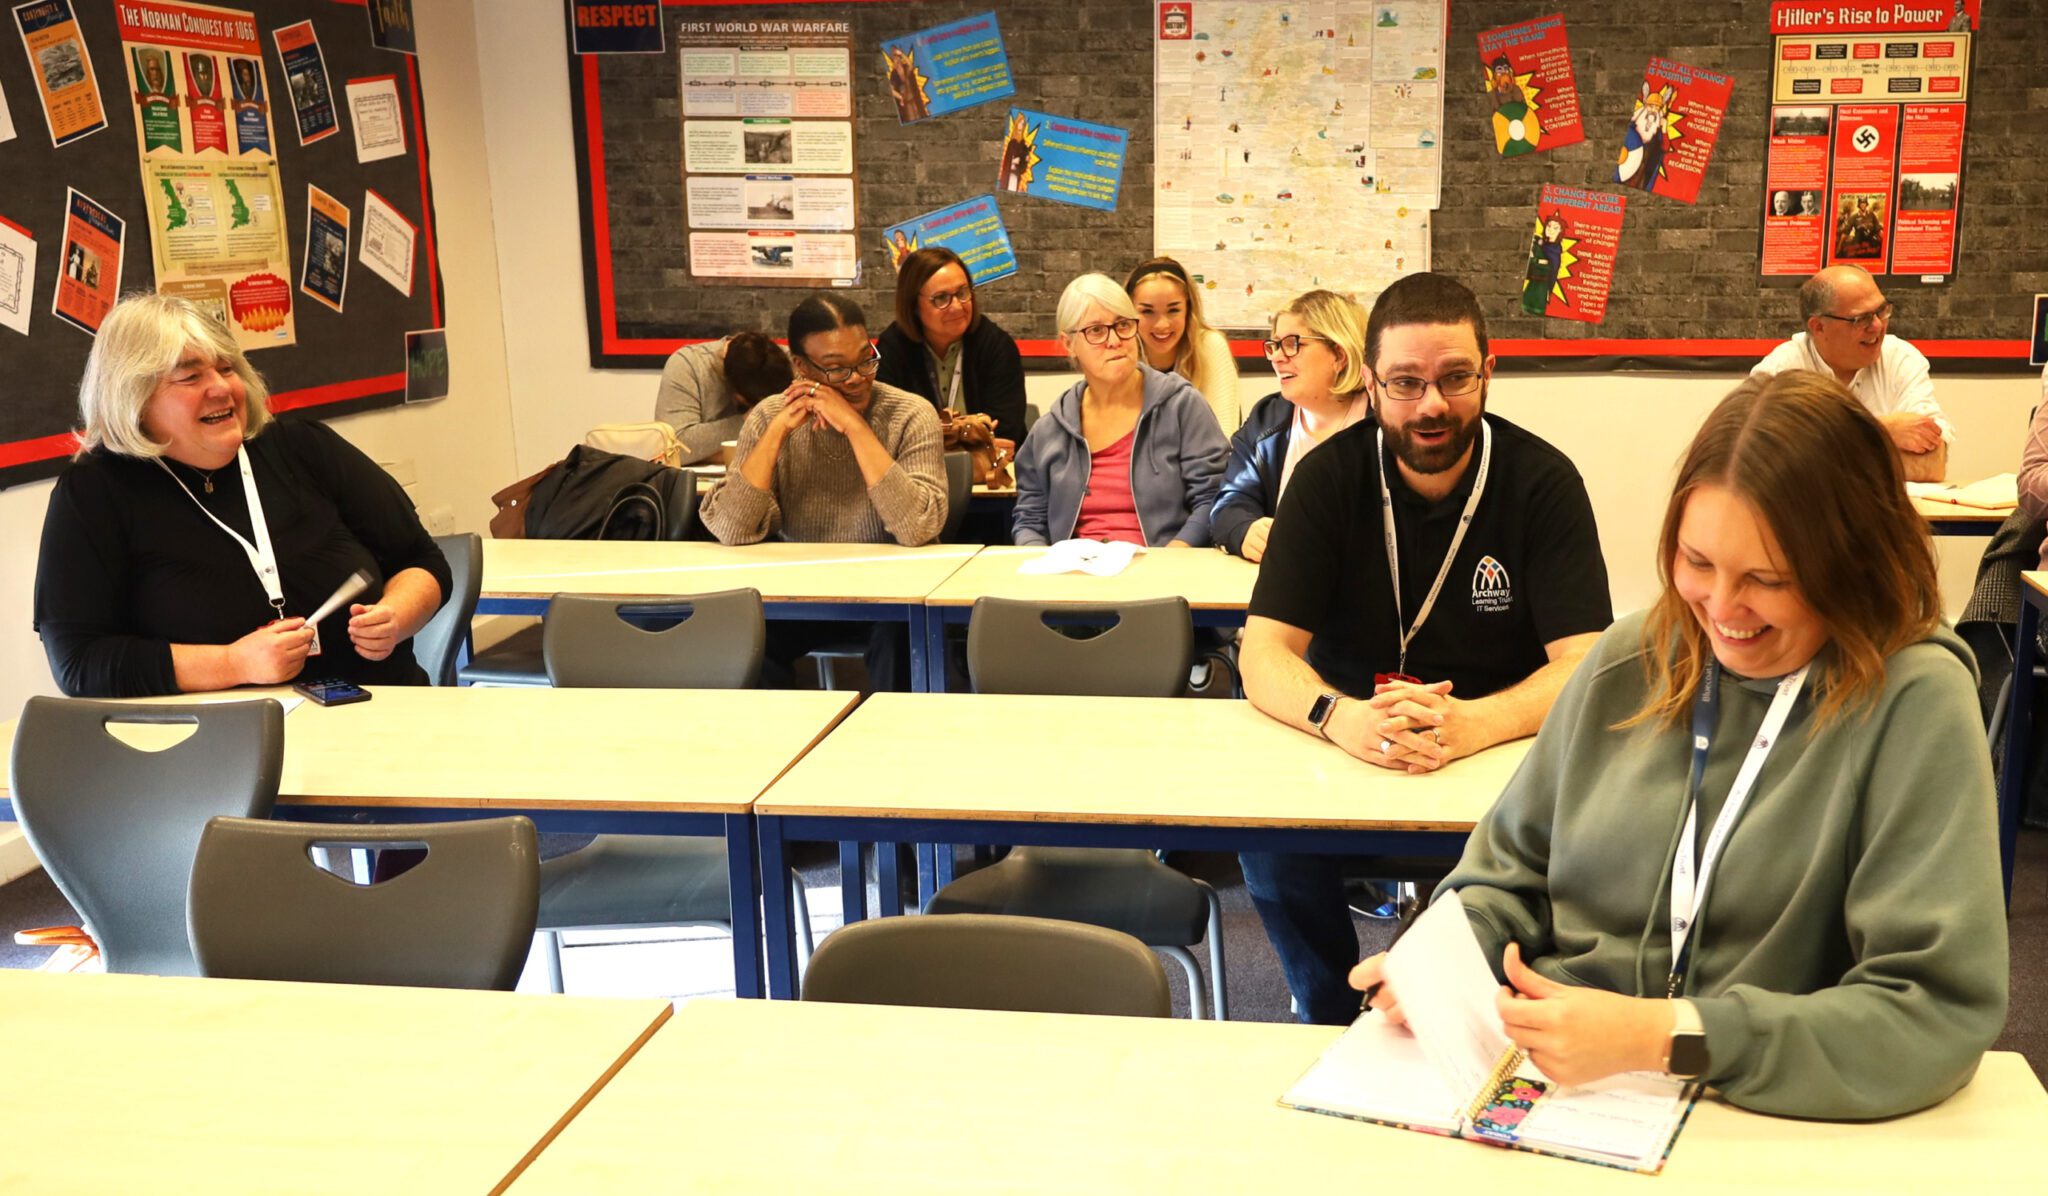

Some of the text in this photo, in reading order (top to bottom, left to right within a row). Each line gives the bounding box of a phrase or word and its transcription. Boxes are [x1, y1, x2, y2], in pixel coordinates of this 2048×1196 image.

[120, 4, 140, 26] THE
[140, 8, 182, 32] NORMAN
[182, 12, 223, 36] CONQUEST
[235, 20, 256, 41] 1066
[577, 4, 656, 28] RESPECT
[1777, 4, 1943, 28] Hitler's Rise to Power
[681, 22, 849, 32] FIRST WORLD WAR WARFARE
[1487, 24, 1532, 43] SOMETIMES
[1533, 17, 1560, 31] THINGS
[1483, 40, 1504, 53] STAY
[1504, 37, 1518, 48] THE
[1518, 44, 1567, 62] When something
[1539, 51, 1568, 63] becomes
[1545, 67, 1556, 76] call
[1557, 64, 1570, 73] that
[1658, 60, 1677, 71] NOT
[1678, 64, 1691, 75] ALL
[1691, 69, 1726, 85] CHANGE
[1556, 84, 1573, 94] When
[1544, 91, 1574, 104] something
[1549, 98, 1575, 110] stays the
[1677, 104, 1689, 113] get
[1710, 113, 1720, 121] we
[1686, 99, 1722, 115] When things
[1553, 114, 1564, 122] call
[1565, 111, 1578, 120] that
[1693, 116, 1718, 128] call that
[1679, 141, 1710, 154] things get
[1694, 138, 1712, 148] When
[1697, 153, 1707, 161] we
[1553, 186, 1587, 199] CHANGE
[1587, 192, 1619, 204] OCCURS
[1552, 196, 1591, 209] DIFFERENT
[1572, 221, 1589, 229] There
[1601, 226, 1619, 235] many
[1574, 228, 1618, 241] different types
[1579, 299, 1596, 307] types
[1588, 293, 1605, 302] other
[1472, 588, 1510, 598] Archway
[1702, 666, 1714, 702] Bluecoat
